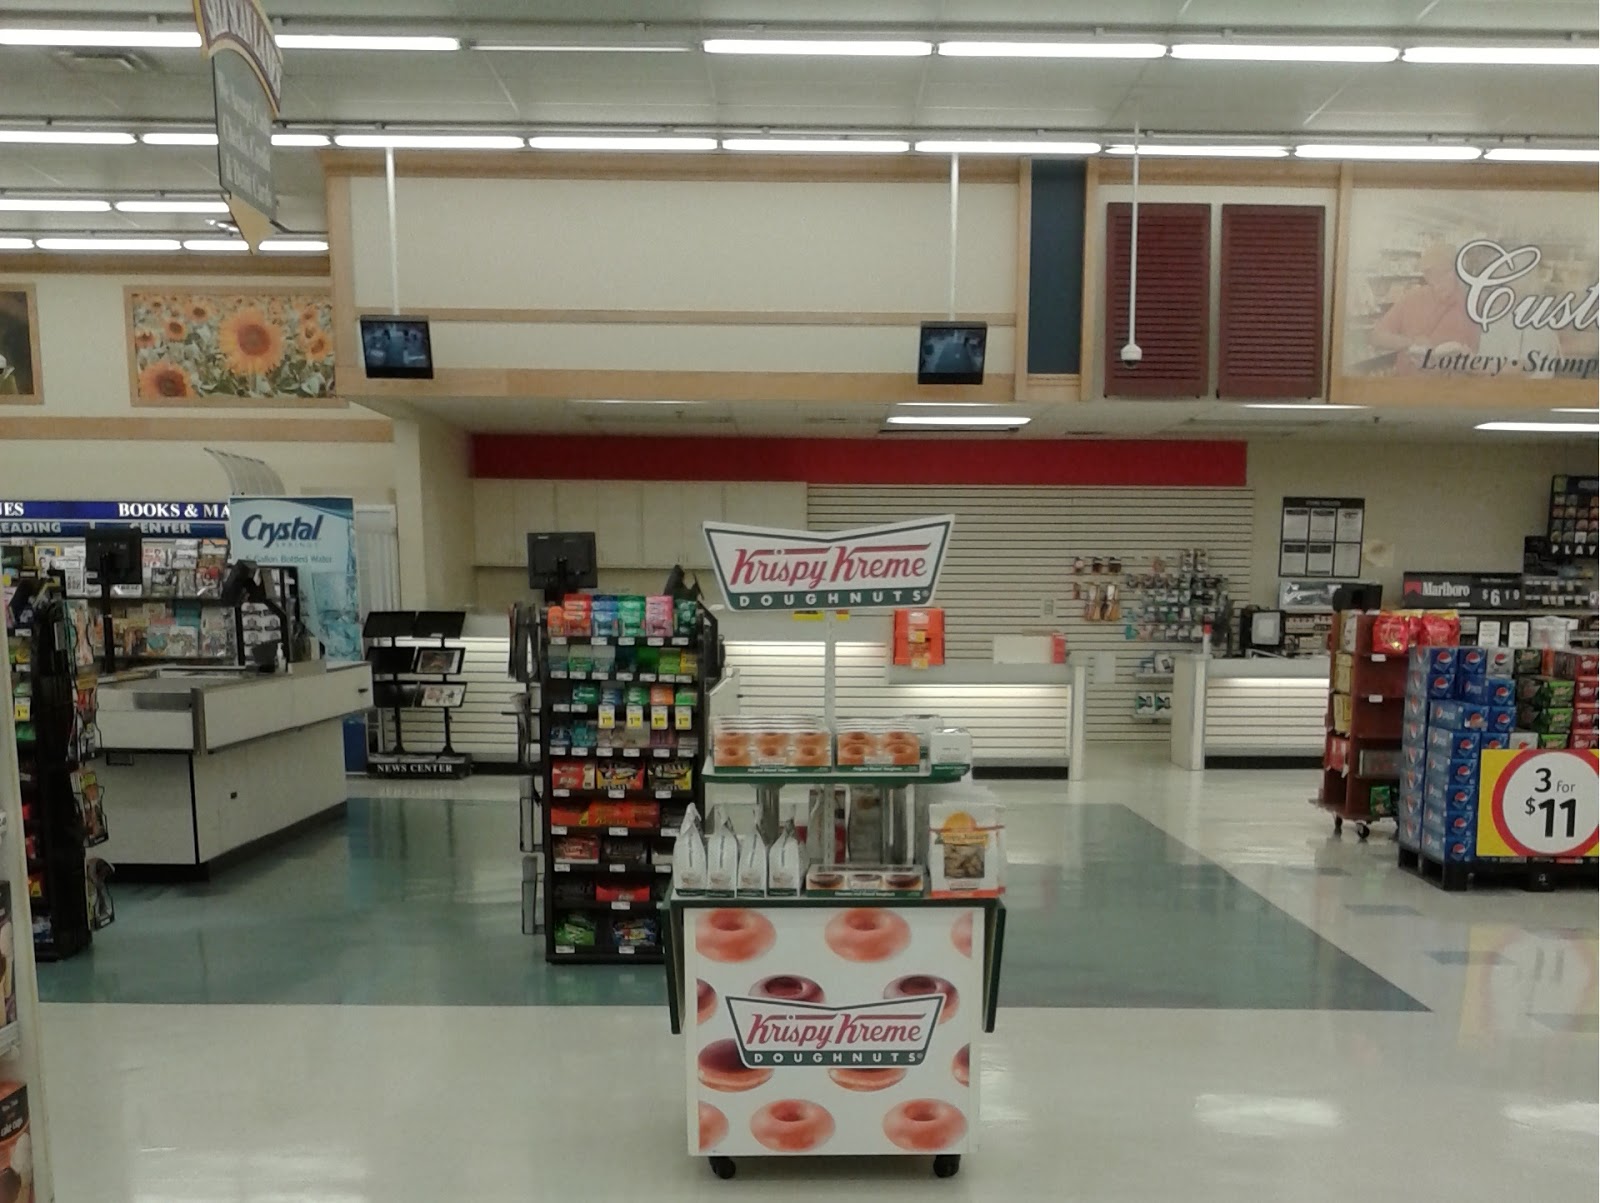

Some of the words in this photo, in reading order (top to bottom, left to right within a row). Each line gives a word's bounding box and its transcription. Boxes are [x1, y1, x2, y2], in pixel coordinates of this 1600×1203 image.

[1421, 349, 1509, 377] Lottery
[0, 502, 24, 517] ES
[118, 502, 180, 518] BOOKS
[184, 503, 198, 518] &
[0, 522, 61, 534] EADING
[241, 514, 324, 549] Crystal
[1551, 544, 1596, 556] PLAY
[730, 546, 831, 589] Krispy
[830, 542, 931, 582] Kreme
[1422, 581, 1470, 597] Marlboro
[740, 591, 922, 607] DOUGHNUTS
[377, 763, 407, 773] NEWS
[410, 763, 453, 773] CENTER
[1534, 768, 1552, 793] 3
[1556, 780, 1576, 793] for
[1524, 797, 1577, 838] $11
[746, 1013, 838, 1050] Krispy
[834, 1013, 928, 1045] Kreme
[754, 1052, 916, 1063] DOUGHNUTS
